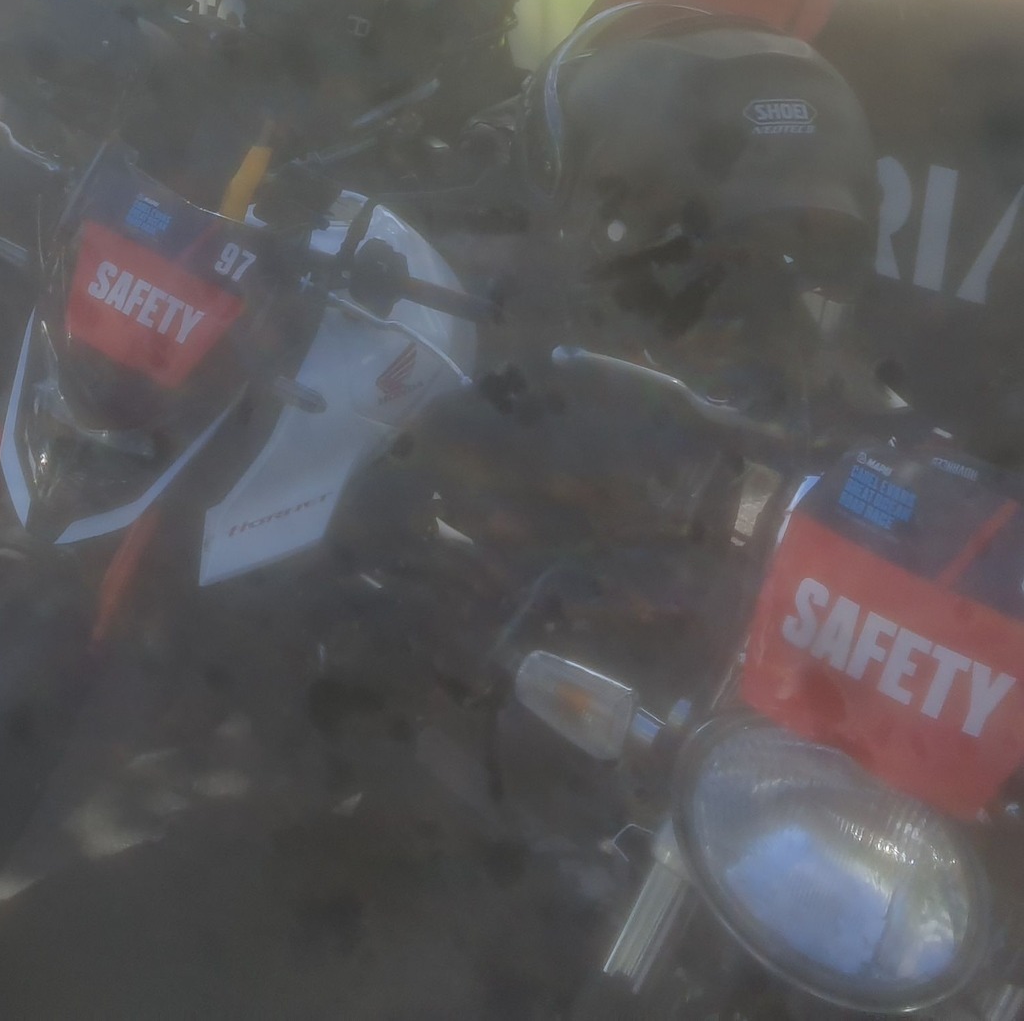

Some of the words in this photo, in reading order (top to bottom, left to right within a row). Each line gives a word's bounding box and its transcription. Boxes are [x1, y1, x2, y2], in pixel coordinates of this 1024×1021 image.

[754, 103, 809, 120] SHOEI
[214, 242, 257, 283] 97
[87, 260, 205, 345] SAFETY
[782, 577, 1017, 738] SAFETY
